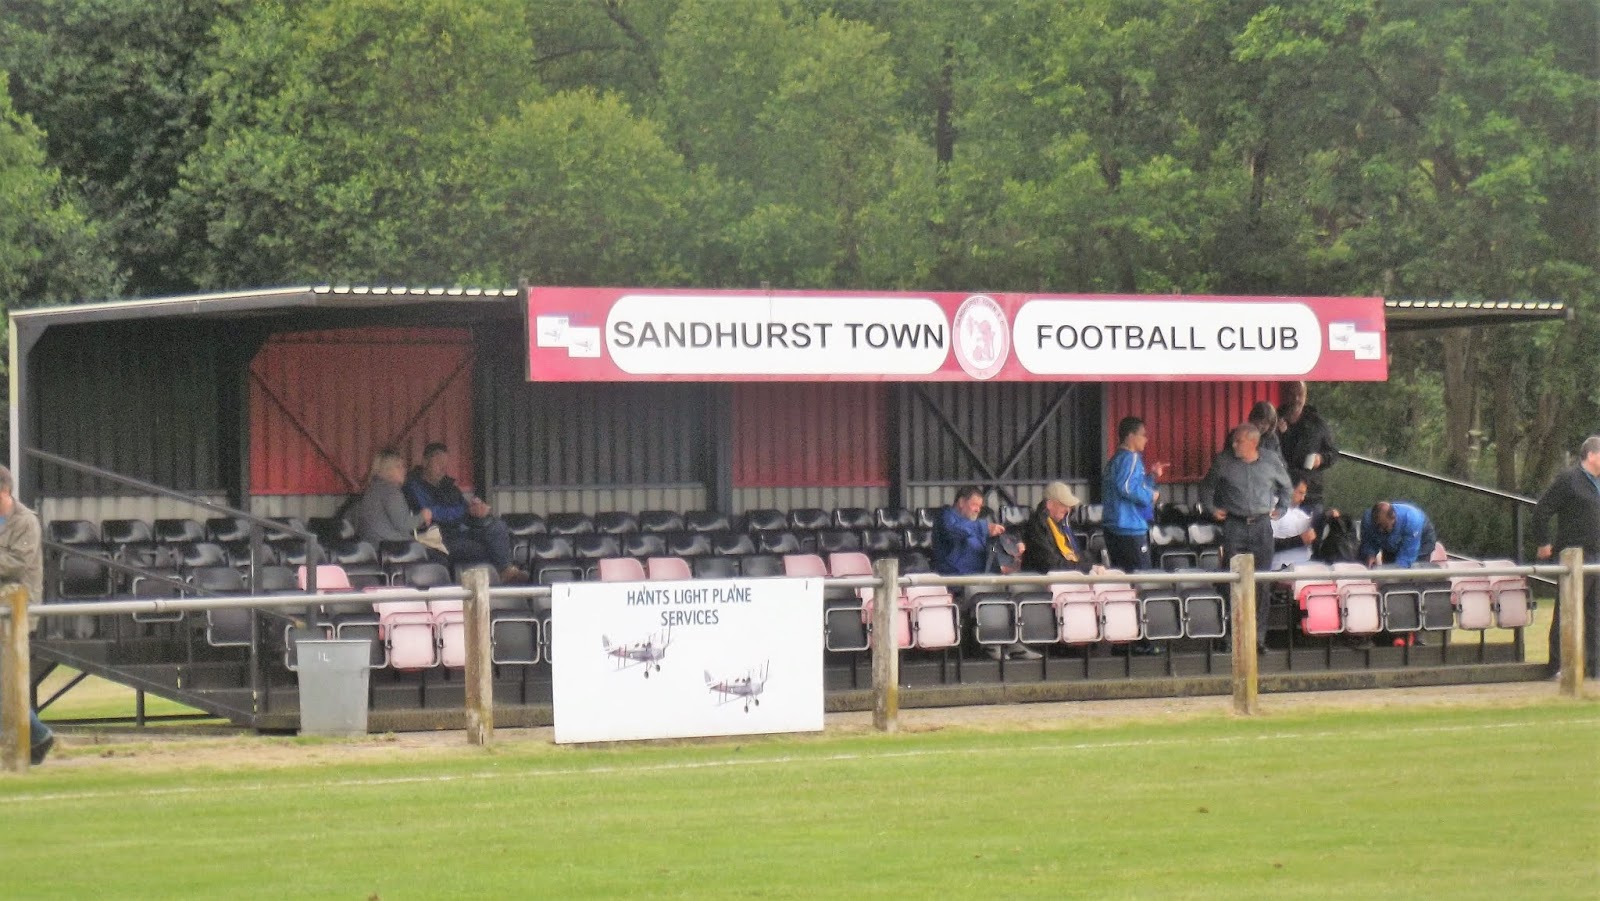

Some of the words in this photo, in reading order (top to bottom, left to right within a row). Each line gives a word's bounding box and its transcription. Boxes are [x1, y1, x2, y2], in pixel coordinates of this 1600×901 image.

[613, 321, 833, 348] SANDHURST
[845, 323, 944, 349] TOWN
[1037, 324, 1206, 351] FOOTBALL
[1217, 326, 1299, 351] CLUB
[627, 589, 670, 605] HANTS
[674, 588, 708, 604] LIGHT
[712, 587, 752, 603] PLANE
[661, 609, 719, 626] SERVICES
